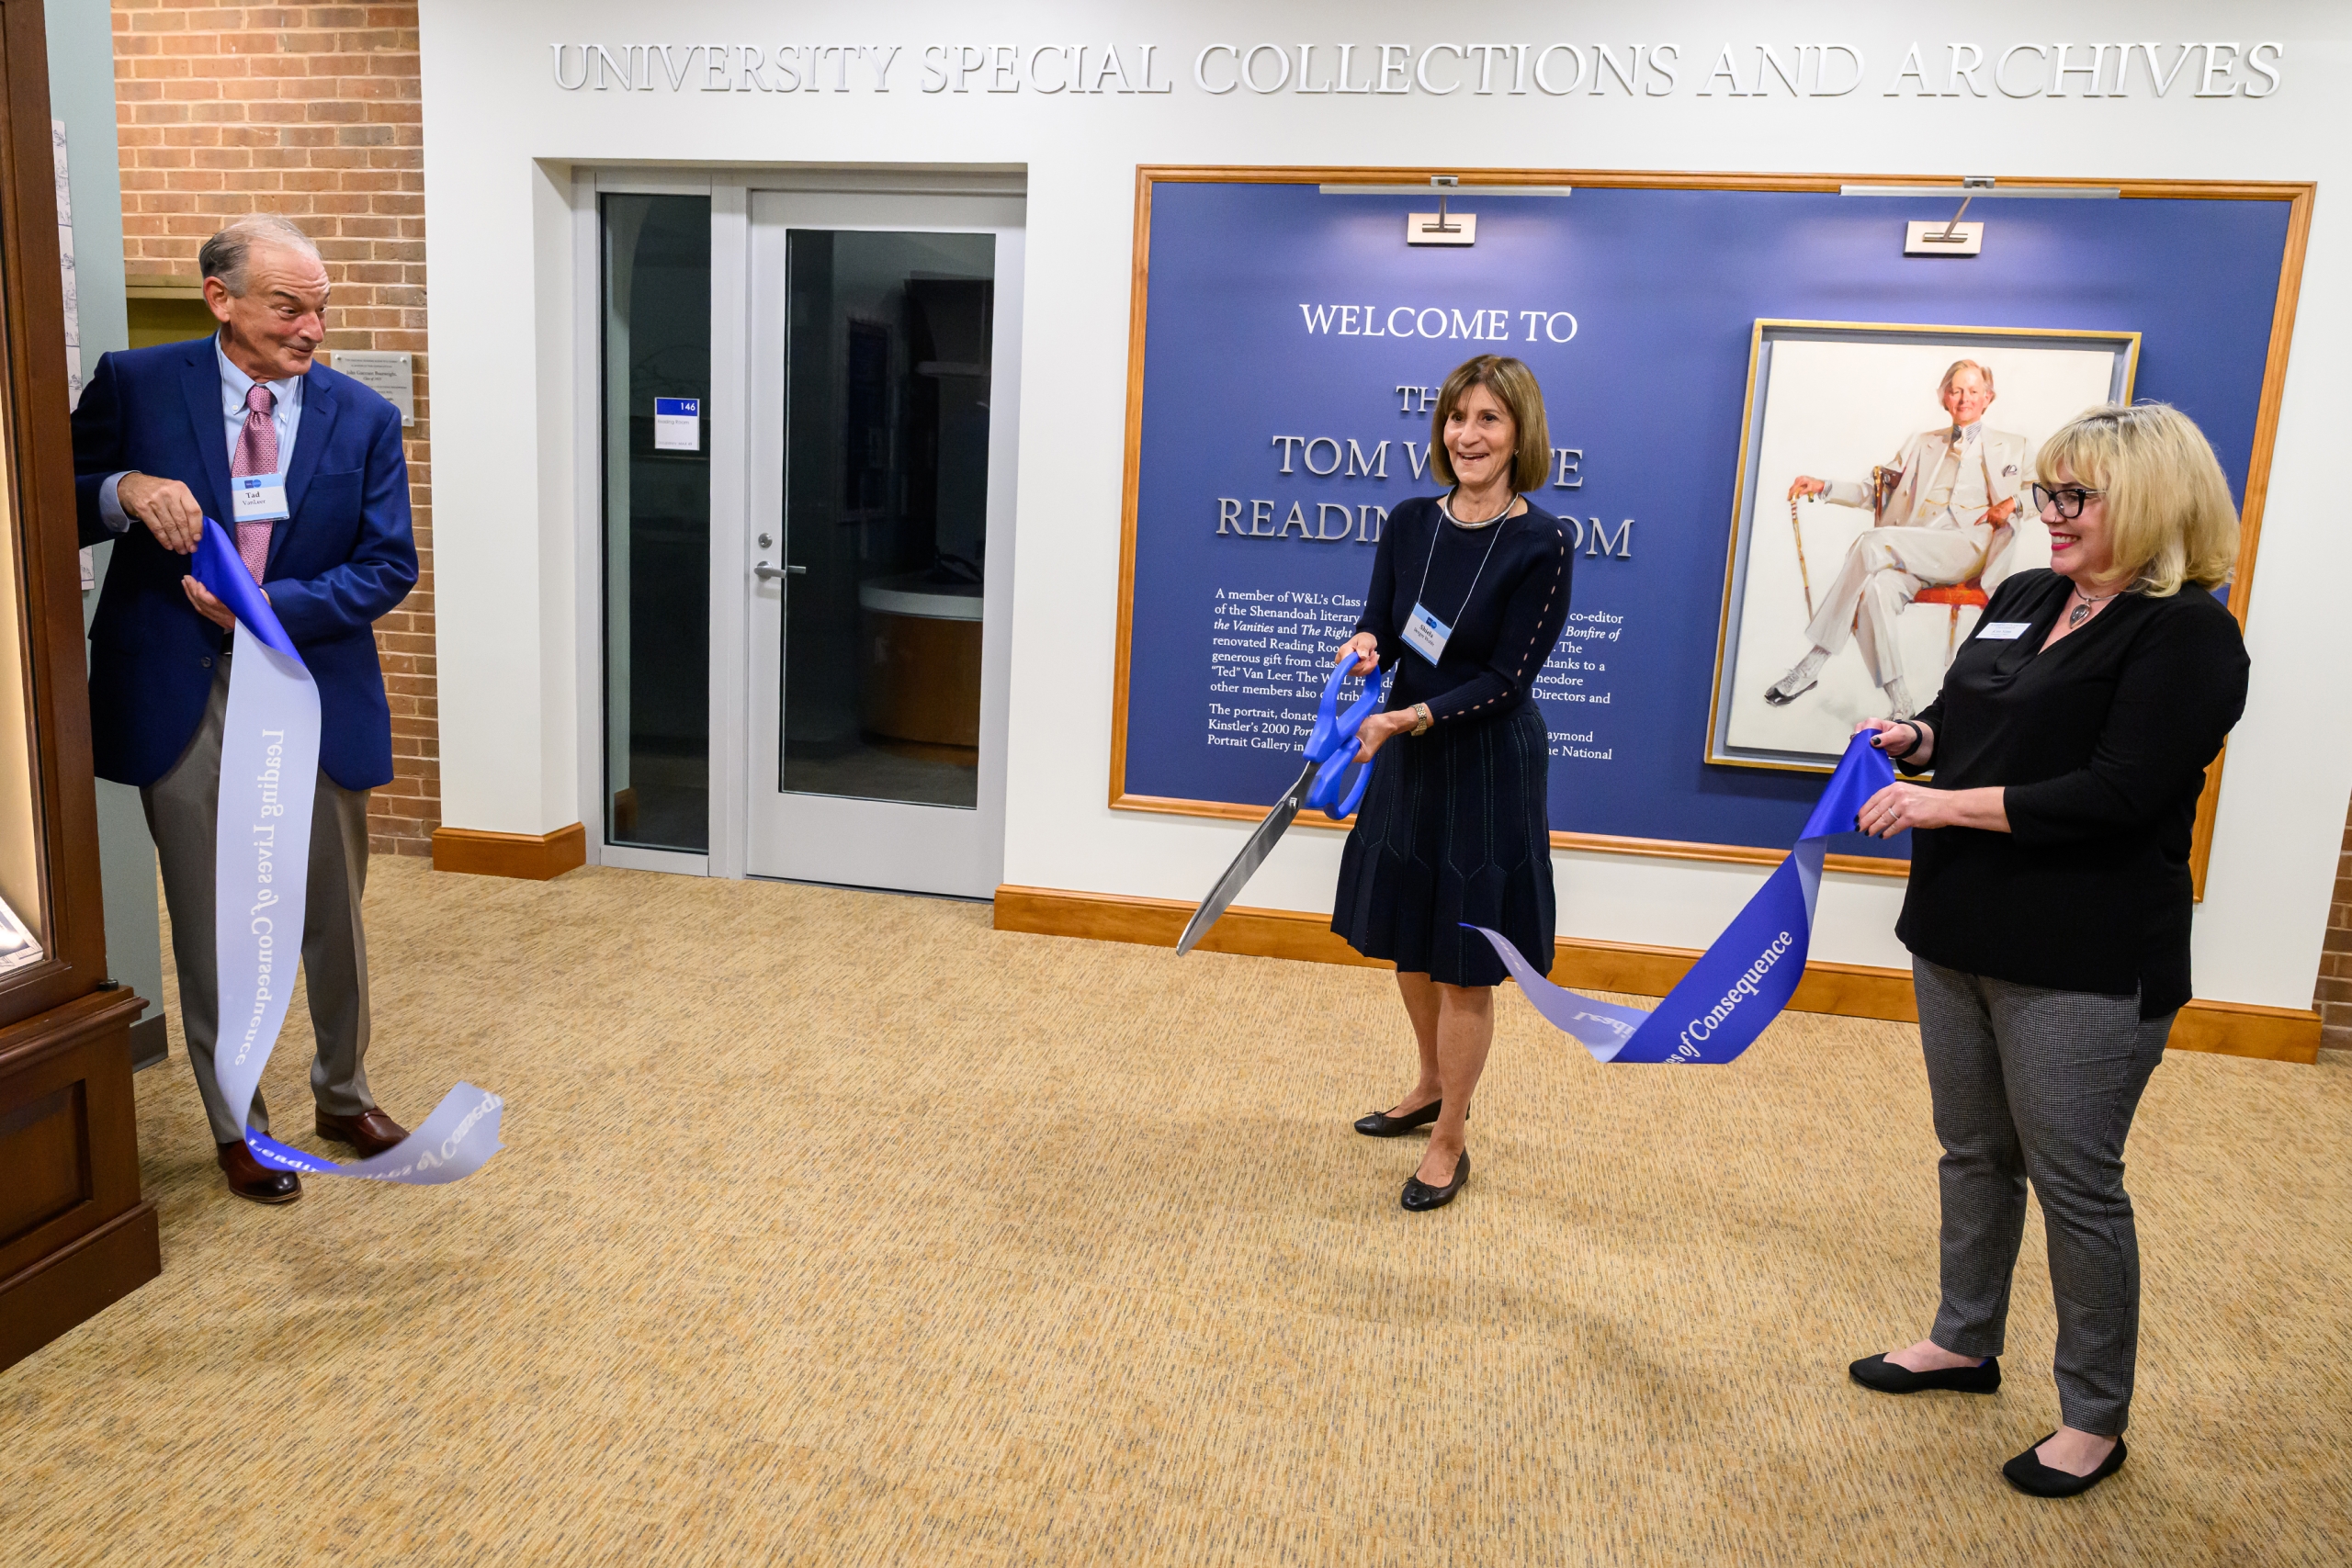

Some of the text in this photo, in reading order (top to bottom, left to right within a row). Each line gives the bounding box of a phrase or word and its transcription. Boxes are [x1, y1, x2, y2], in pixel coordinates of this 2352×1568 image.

[550, 40, 2284, 98] UNIVERSITY SPECIAL COLLECTIONS AND ARCHIVES
[1299, 303, 1578, 344] WELCOME TO
[681, 402, 695, 411] 146
[1396, 385, 1441, 412] TH
[1272, 434, 1391, 478] TOM
[1216, 497, 1388, 543] READIN
[1215, 587, 1226, 599] A
[1228, 589, 1274, 602] member
[1277, 591, 1291, 603] of
[1291, 592, 1329, 604] W&L's
[1331, 594, 1361, 607] Class
[1215, 603, 1623, 626] of the Shenandoah literary co-editor
[1214, 618, 1622, 642] the Vanities and The Right Bonfire of
[1213, 637, 1583, 654] renovated Reading Roo The
[1212, 652, 1261, 663] generous
[1262, 653, 1282, 667] gift
[1284, 654, 1312, 667] from
[1583, 660, 1596, 671] to
[1599, 663, 1606, 671] a
[1242, 667, 1263, 679] Van
[1267, 669, 1294, 682] Leer.
[1295, 671, 1318, 683] The
[1534, 672, 1584, 686] heodore
[1210, 681, 1239, 693] other
[1241, 683, 1293, 697] members
[1295, 686, 1317, 699] also
[1532, 687, 1586, 702] Directors
[1589, 692, 1611, 704] and
[1208, 703, 1593, 742] The portrait, donate aymond
[1207, 734, 1305, 753] Portrait Gallery in
[1208, 718, 1259, 733] Kinstler's
[1261, 722, 1290, 735] 2000
[1562, 745, 1612, 760] National
[1678, 931, 1793, 1058] of Consequence
